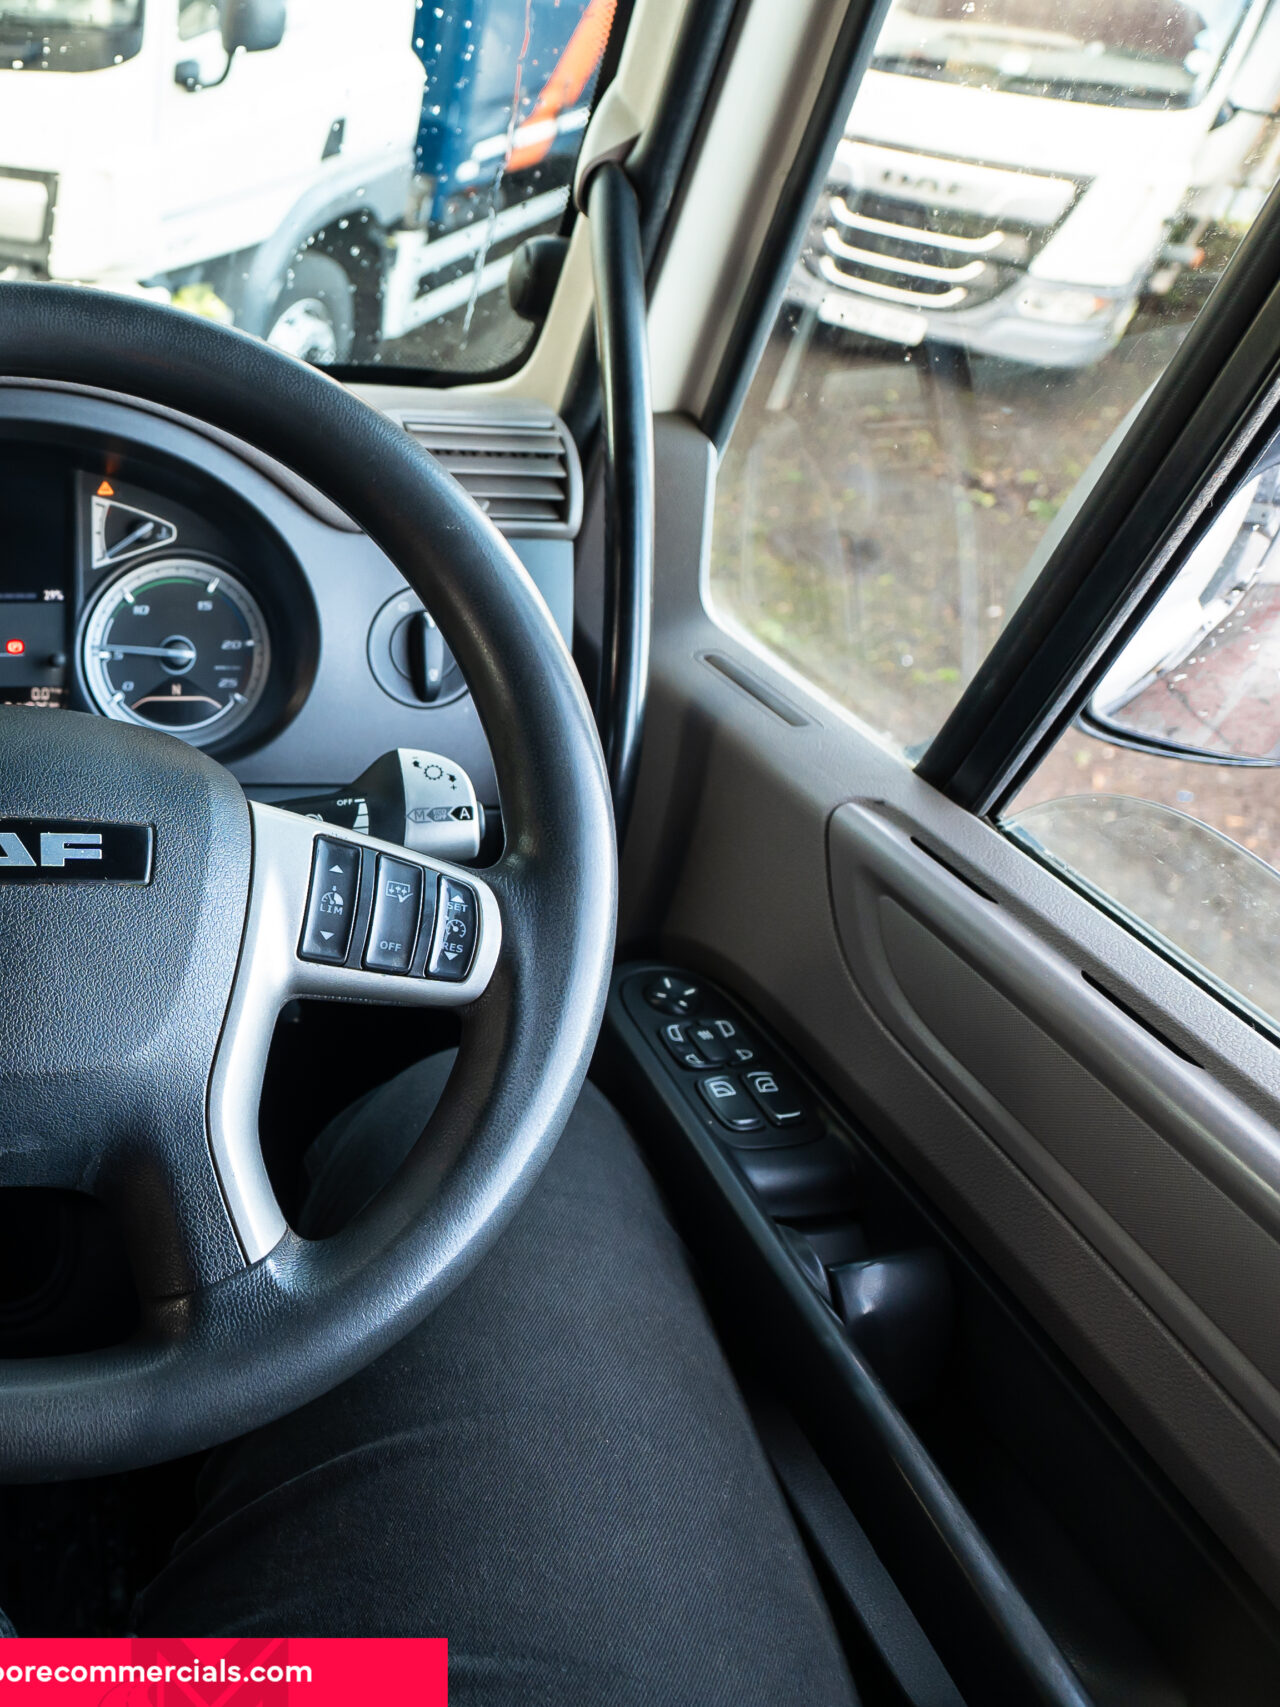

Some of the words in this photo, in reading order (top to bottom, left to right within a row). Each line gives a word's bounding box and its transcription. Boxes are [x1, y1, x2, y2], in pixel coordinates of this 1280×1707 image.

[132, 605, 150, 616] 10
[197, 601, 213, 612] 15
[221, 639, 243, 650] 20
[218, 677, 238, 689] 25
[171, 684, 182, 695] N
[336, 798, 353, 806] OFF
[415, 809, 425, 821] M
[459, 807, 471, 820] A
[320, 903, 343, 915] LIM
[447, 902, 469, 913] SET
[380, 940, 403, 952] OFF
[442, 942, 464, 953] RES
